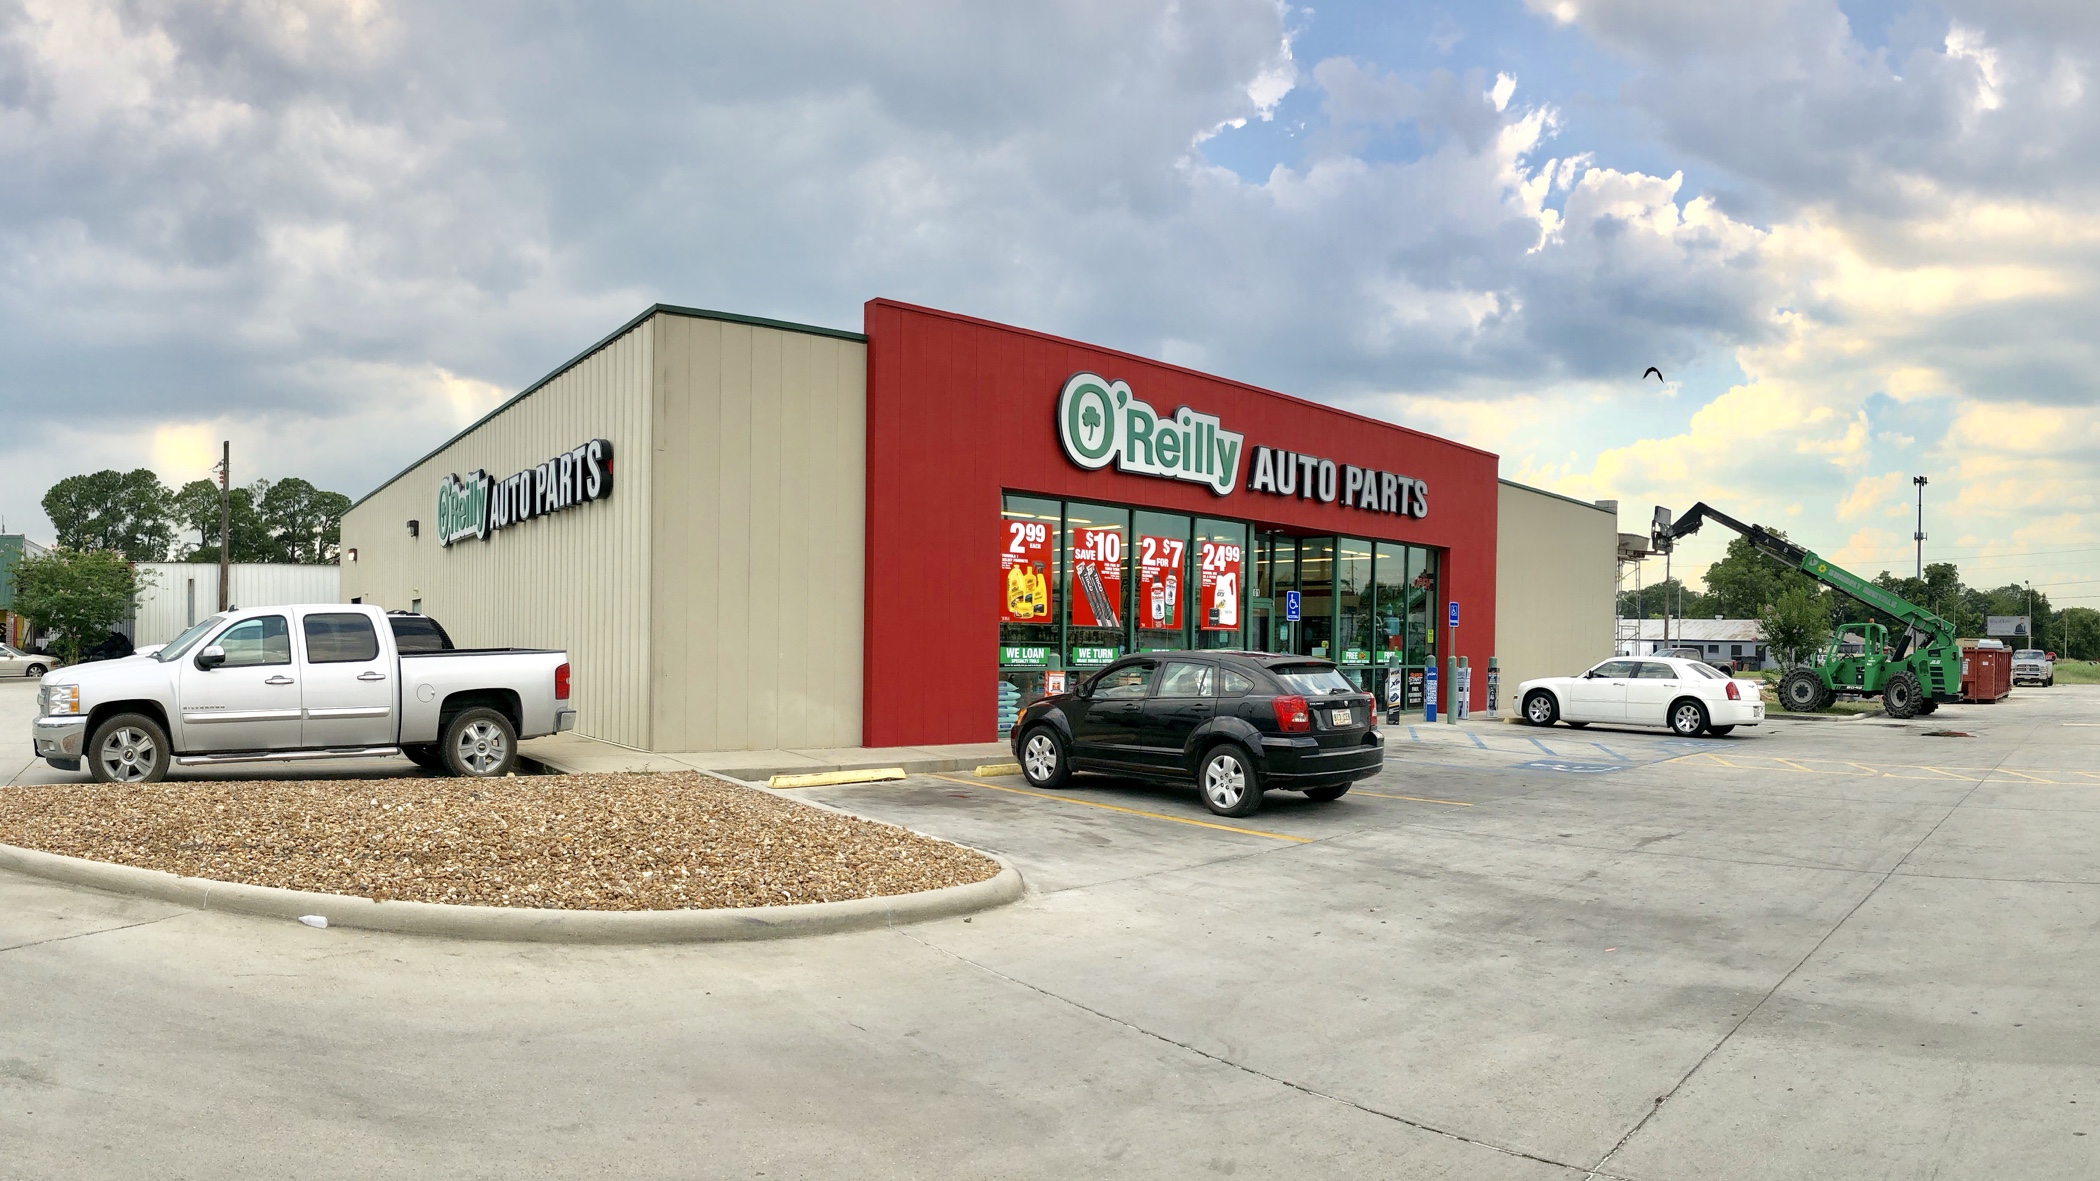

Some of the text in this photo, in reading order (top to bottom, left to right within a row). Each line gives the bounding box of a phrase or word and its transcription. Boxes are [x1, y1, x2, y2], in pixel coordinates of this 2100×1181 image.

[1067, 382, 1428, 519] O'Reilly AUTO PARTS
[438, 439, 605, 541] O'Reilly AUTO PARTS
[1075, 530, 1120, 563] SAVE $10
[1142, 537, 1183, 568] 2 FOR $7
[1094, 572, 1103, 592] TRICO
[1006, 648, 1045, 658] WE LOAN
[1079, 648, 1113, 658] WE TURN
